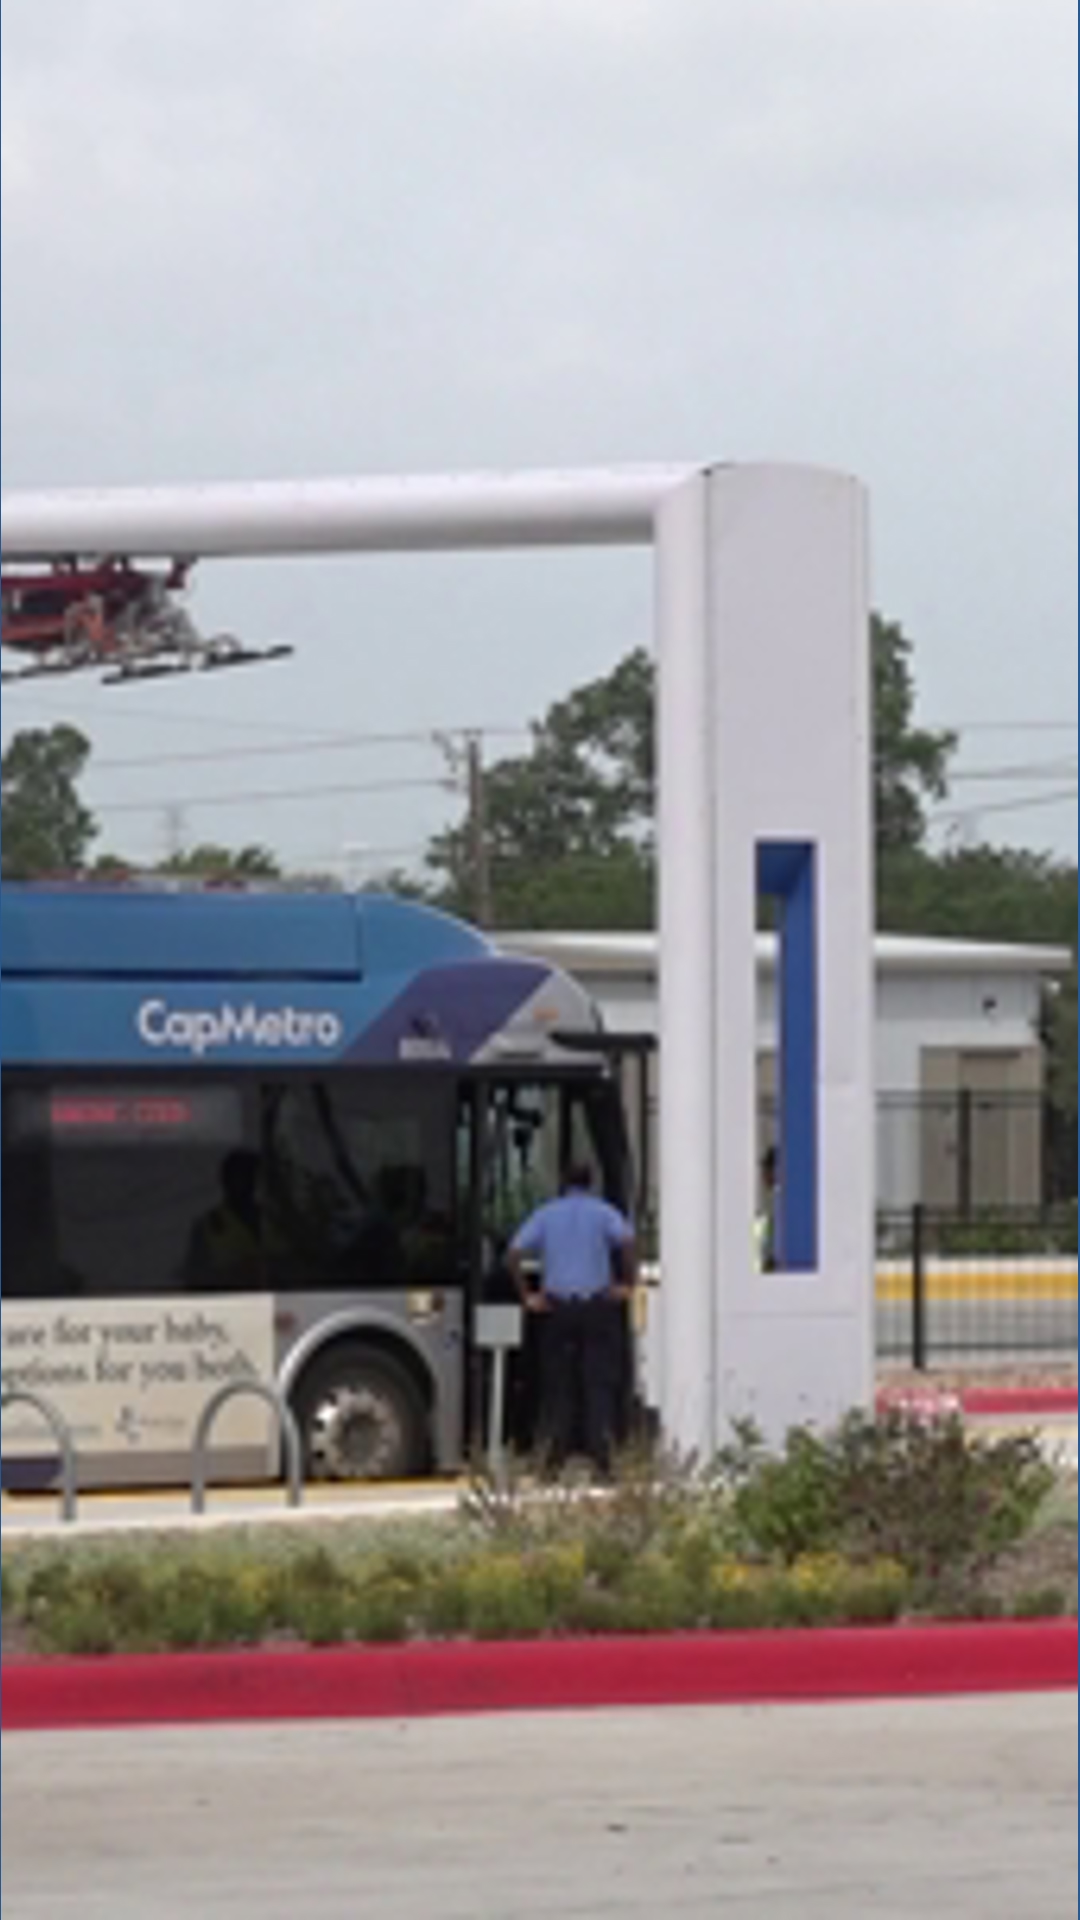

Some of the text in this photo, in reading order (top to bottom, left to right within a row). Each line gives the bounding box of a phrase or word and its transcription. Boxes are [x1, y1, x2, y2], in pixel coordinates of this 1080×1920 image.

[136, 999, 342, 1055] CapMetro
[53, 1314, 91, 1343] for
[98, 1322, 156, 1358] your
[95, 1352, 134, 1383] for
[139, 1359, 187, 1393] you
